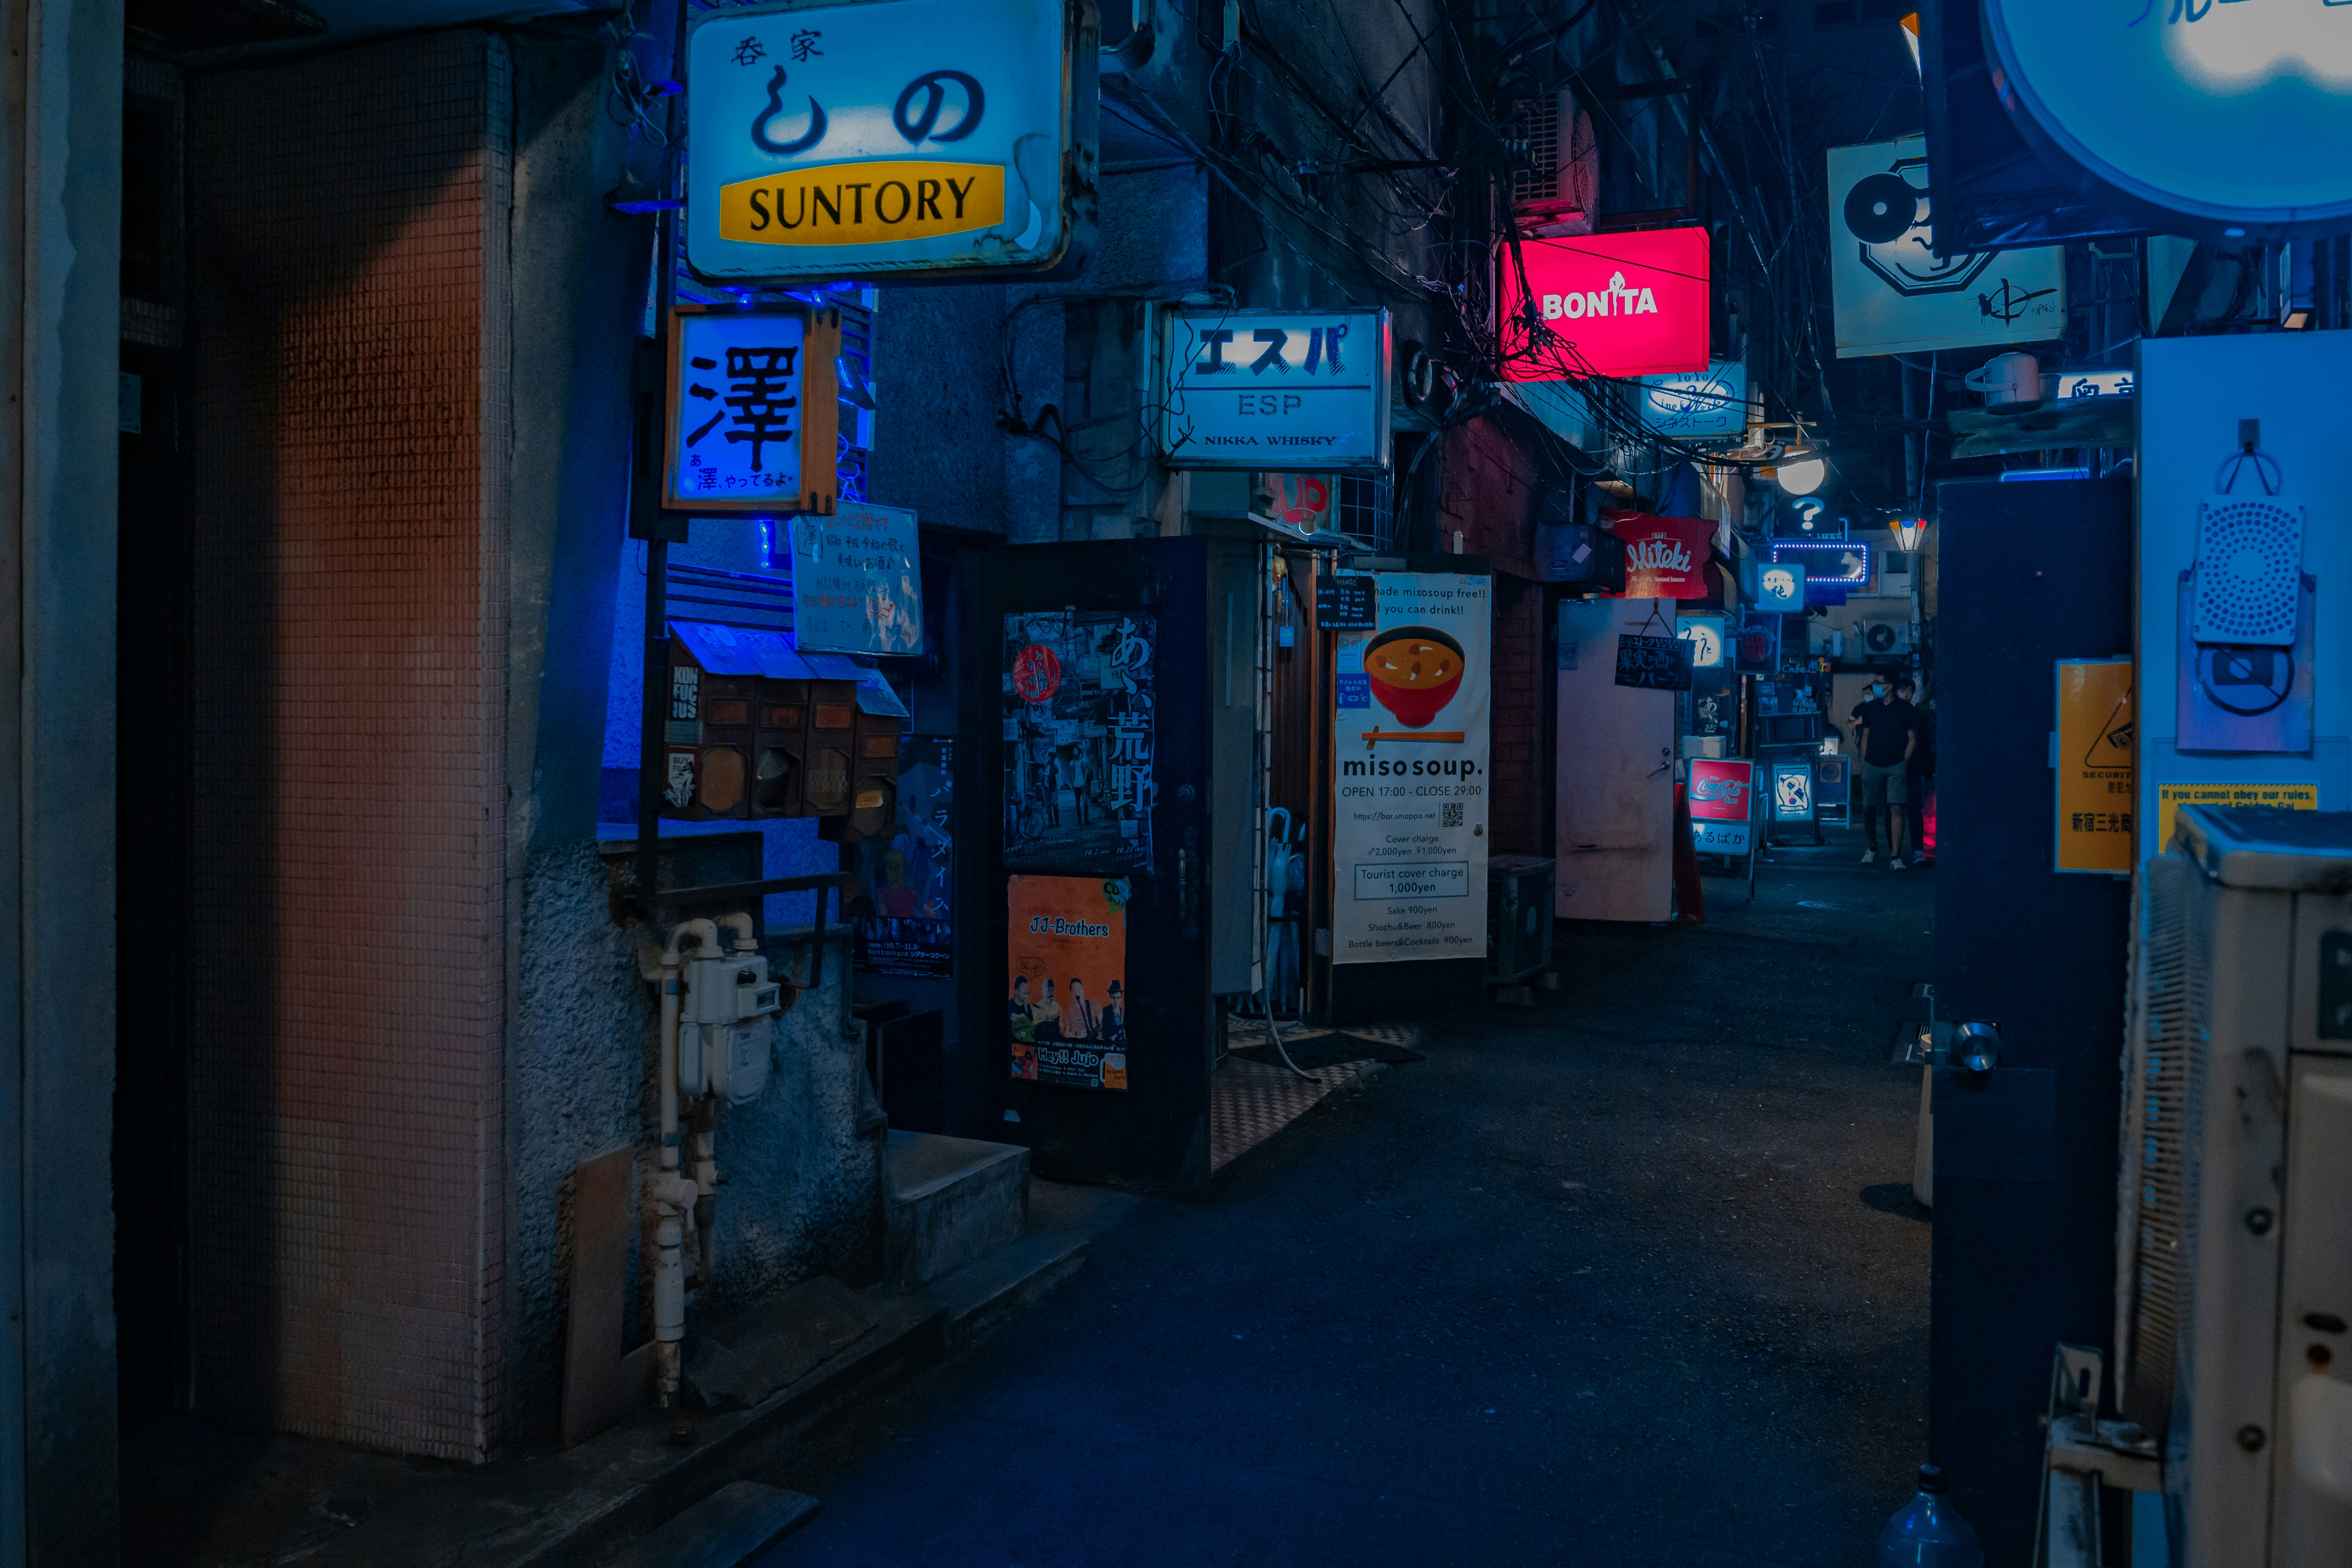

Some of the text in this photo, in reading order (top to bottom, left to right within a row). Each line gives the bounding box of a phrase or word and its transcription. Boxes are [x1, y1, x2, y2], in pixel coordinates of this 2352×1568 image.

[751, 65, 985, 155] しの
[749, 176, 975, 232] SUNTORY
[1543, 271, 1658, 320] BONITA
[1195, 323, 1348, 376] エスパ
[686, 346, 799, 473] 澤
[1238, 394, 1302, 416] ESP
[1204, 435, 1337, 446] NIKKA WHISKY
[690, 454, 702, 468] あ
[1403, 589, 1453, 598] misosoup
[1457, 588, 1486, 598] free!!
[1385, 606, 1403, 615] you
[1430, 605, 1464, 615] drink!!
[1342, 786, 1374, 797] OPEN
[1378, 787, 1406, 797] 17:00
[1416, 786, 1450, 796] CLOSE
[1454, 786, 1481, 796] 29:00
[1696, 778, 1743, 797] Coca-Cola
[2172, 791, 2190, 800] you
[2194, 790, 2230, 799] cannot
[2233, 790, 2258, 800] obey
[2262, 791, 2279, 799] our
[1354, 811, 1436, 822] https://bar.smappa.net
[1386, 835, 1439, 844] Cover charge
[1693, 829, 1745, 845] あるぱか
[929, 780, 953, 911] パラダイス
[1361, 867, 1464, 880] Tourist cover charge
[1103, 882, 1120, 895] CD
[1389, 883, 1436, 895] 1,000yen
[1408, 906, 1437, 915] 900yen
[1030, 916, 1109, 937] JJ-Brothers
[1368, 921, 1455, 931] Shochu&Beer 800yen
[1348, 936, 1472, 949] Bottle beers&Cocktails 900yen
[867, 949, 950, 959] Bunkamura シアターコクーン
[1038, 1047, 1098, 1067] Hey!! Jujo
